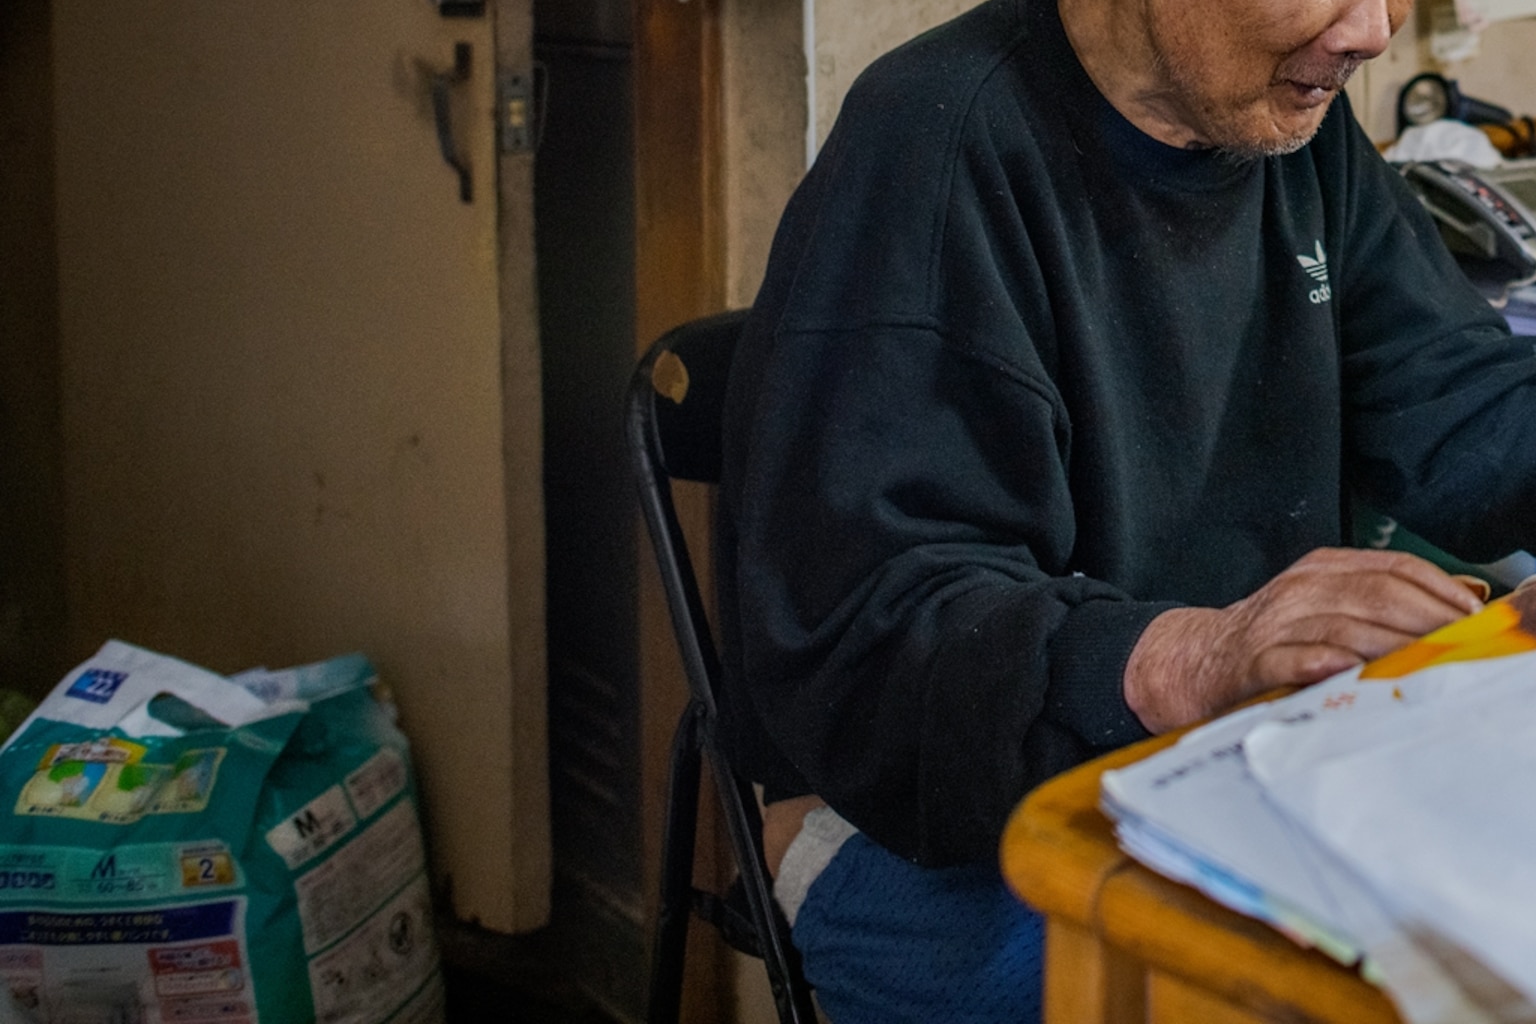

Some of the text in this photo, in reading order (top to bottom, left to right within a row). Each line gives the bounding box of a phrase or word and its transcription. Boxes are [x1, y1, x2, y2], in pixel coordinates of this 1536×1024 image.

[292, 809, 321, 839] M
[91, 854, 116, 880] M
[199, 858, 215, 880] 2
